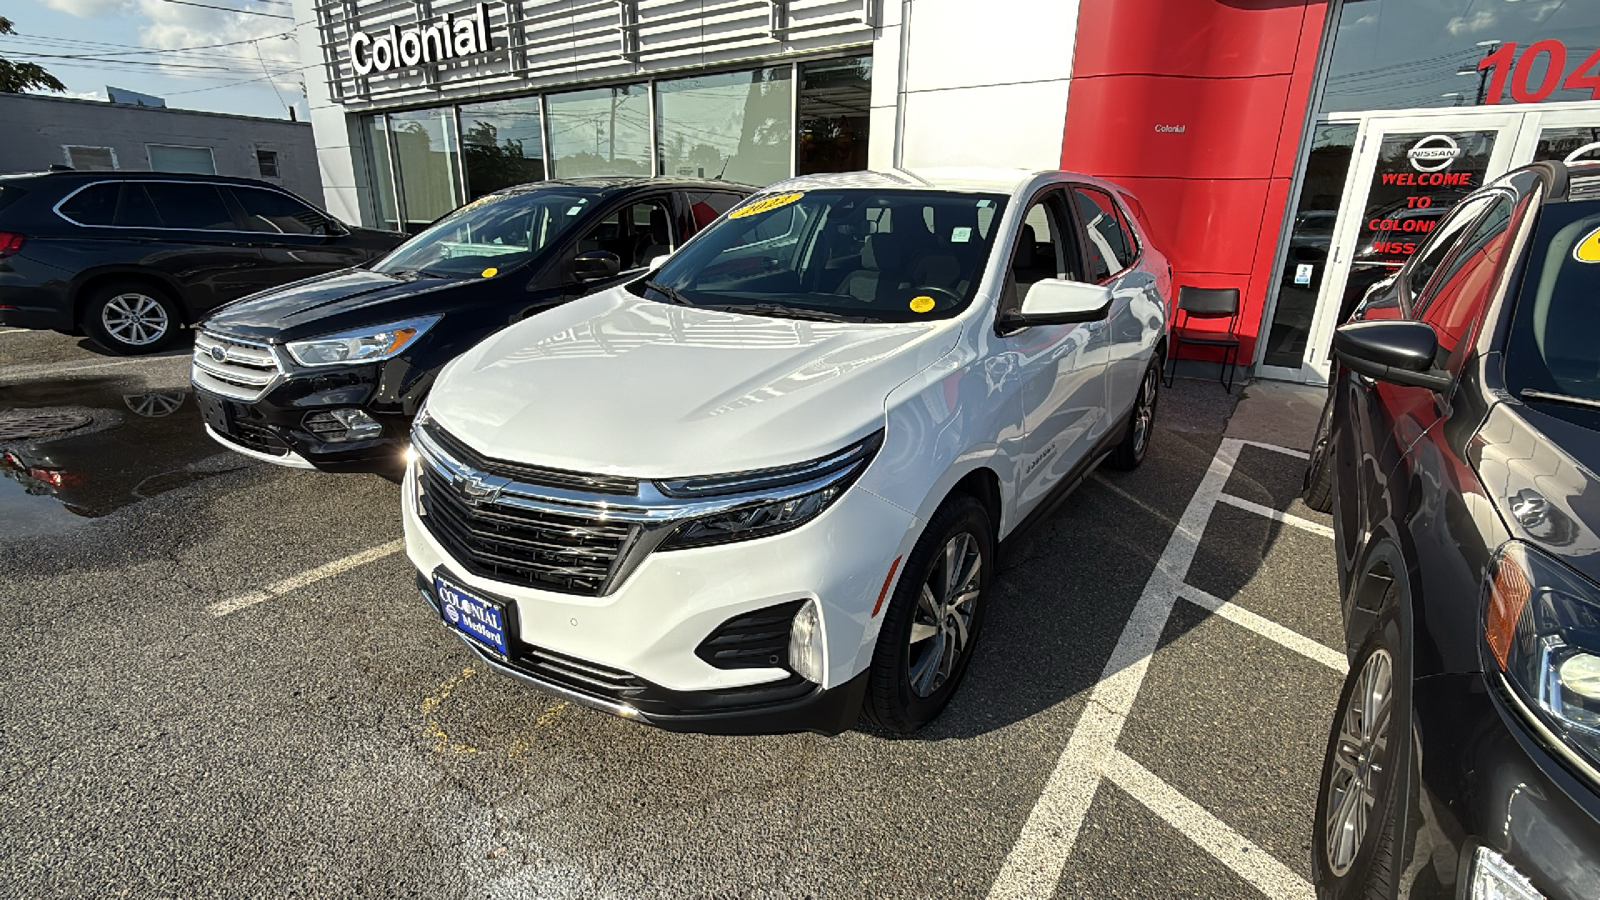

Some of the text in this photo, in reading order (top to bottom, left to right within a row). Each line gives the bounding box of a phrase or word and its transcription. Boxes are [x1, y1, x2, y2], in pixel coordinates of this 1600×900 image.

[351, 2, 488, 75] Colonial
[1154, 123, 1186, 133] Colonial
[1411, 149, 1456, 159] NISSAN
[1382, 172, 1472, 186] WELCOME
[1406, 196, 1432, 209] TO
[440, 587, 502, 631] COLONIAL
[462, 613, 502, 646] Medford
